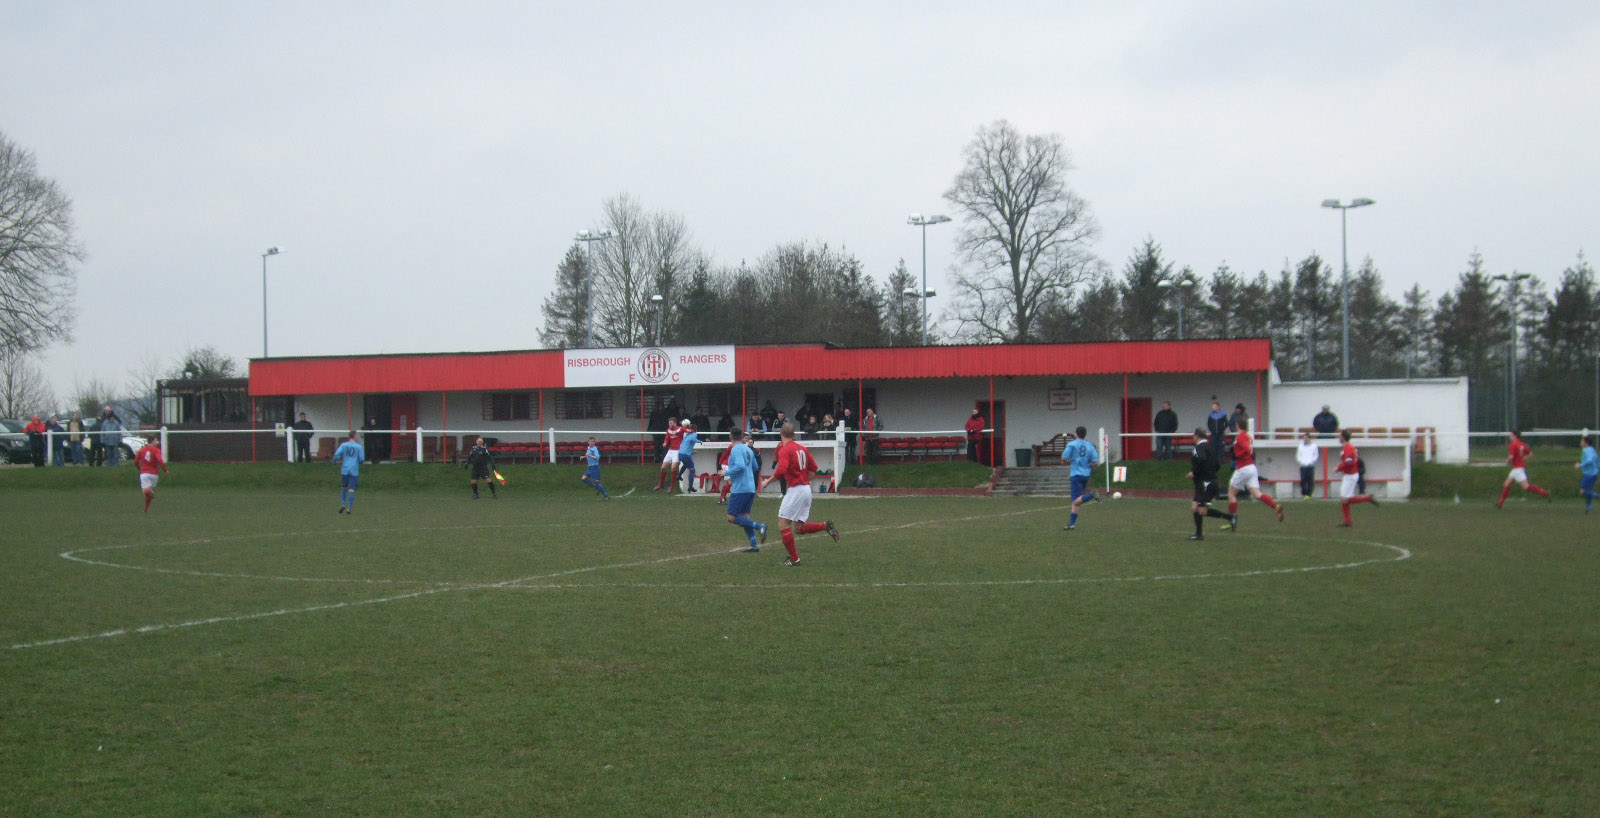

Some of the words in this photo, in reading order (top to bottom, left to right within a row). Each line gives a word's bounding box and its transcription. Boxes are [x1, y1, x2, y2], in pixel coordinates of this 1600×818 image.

[567, 357, 631, 368] RISBOROUGH
[680, 354, 727, 364] RANGERS
[629, 374, 635, 383] F
[672, 372, 680, 382] C
[345, 446, 355, 457] 10
[1079, 445, 1086, 457] 8
[796, 449, 807, 471] 10
